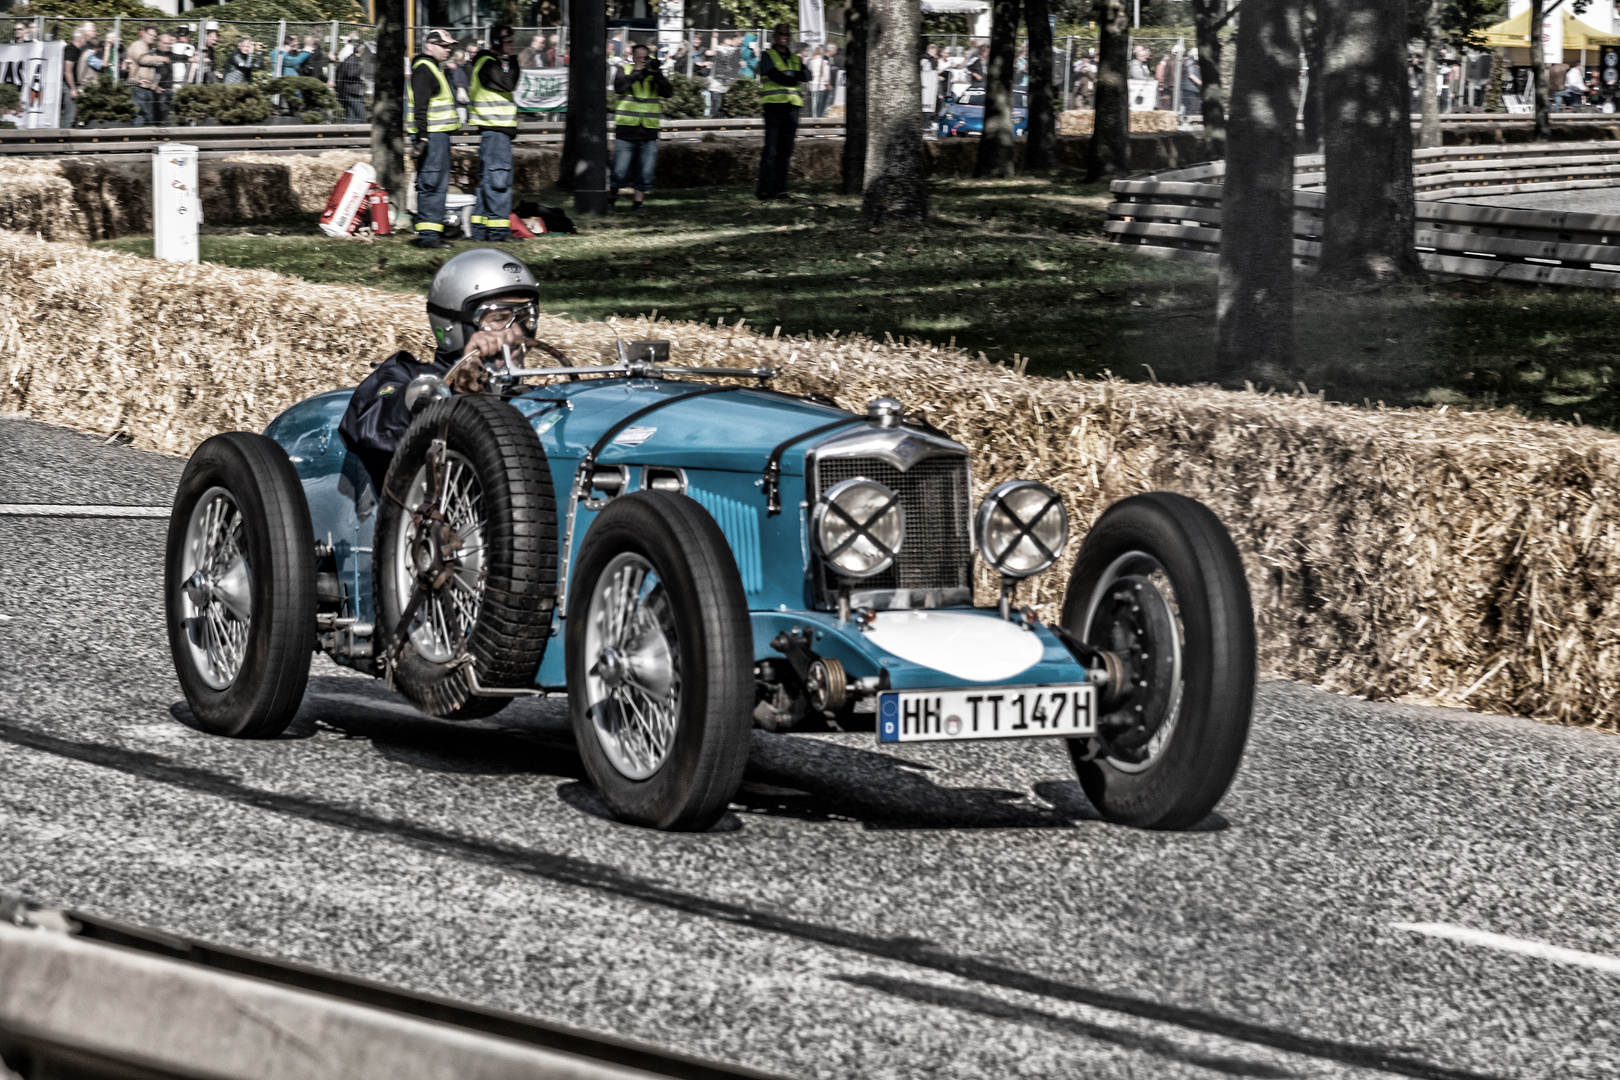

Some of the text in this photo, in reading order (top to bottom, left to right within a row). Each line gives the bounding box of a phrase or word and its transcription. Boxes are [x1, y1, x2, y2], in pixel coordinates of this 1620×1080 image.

[902, 691, 1091, 735] HH TT 147H
[884, 721, 895, 734] D
